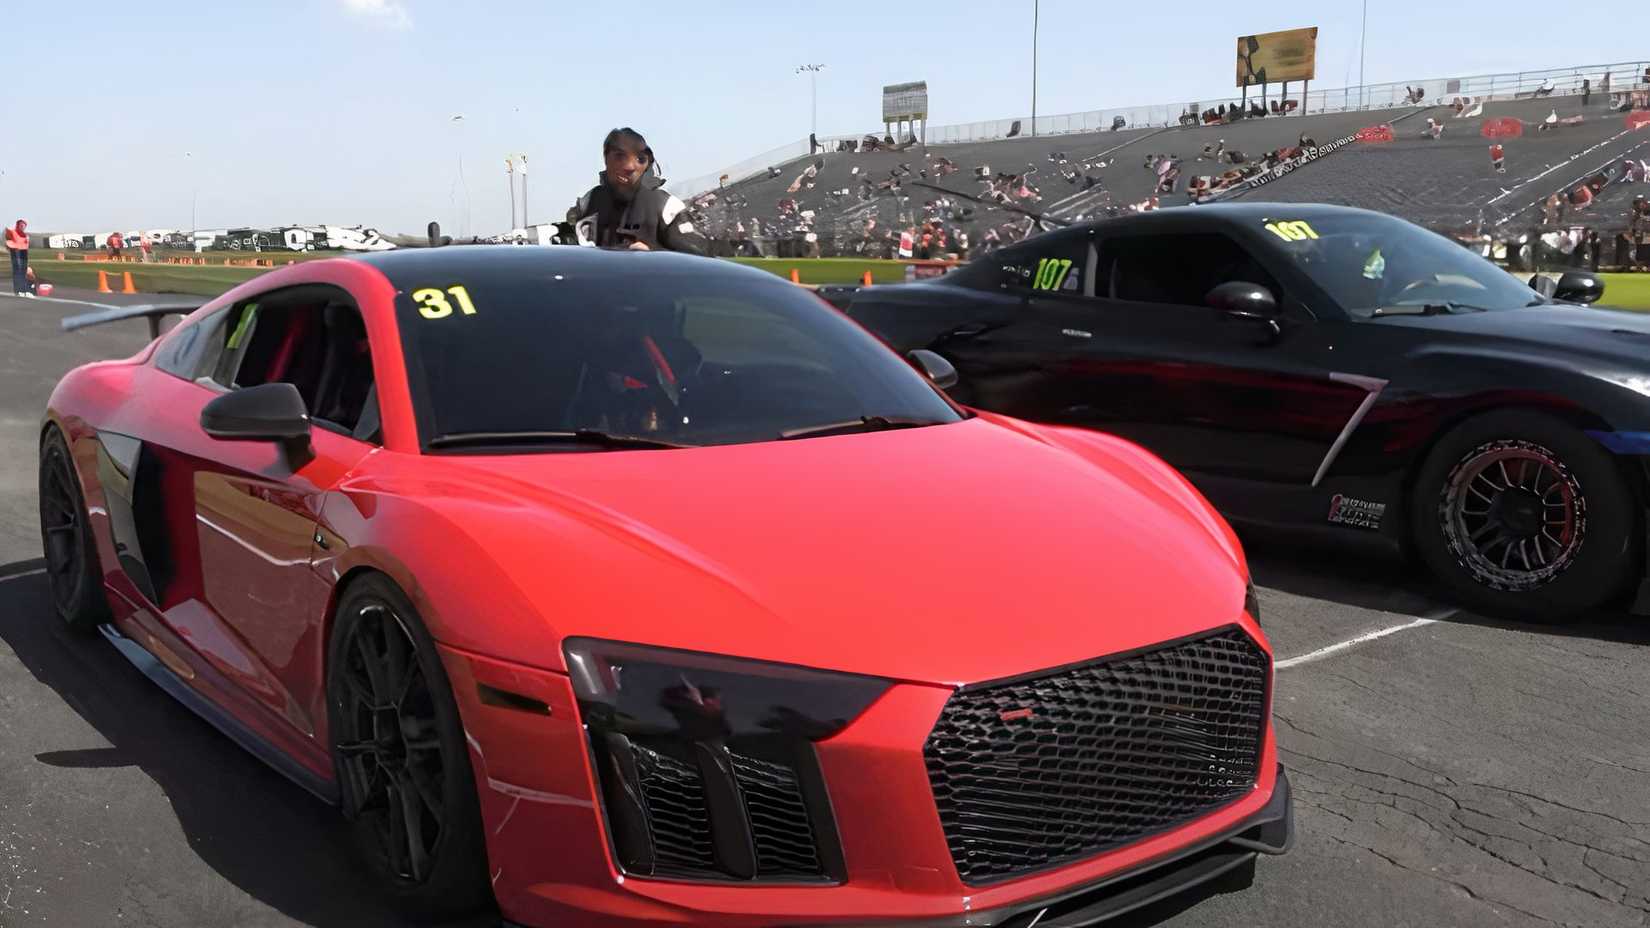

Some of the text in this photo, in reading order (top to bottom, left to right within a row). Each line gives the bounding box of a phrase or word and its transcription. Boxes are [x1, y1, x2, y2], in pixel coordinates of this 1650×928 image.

[1264, 221, 1319, 241] 107
[1033, 258, 1072, 290] 107
[412, 285, 477, 319] 31
